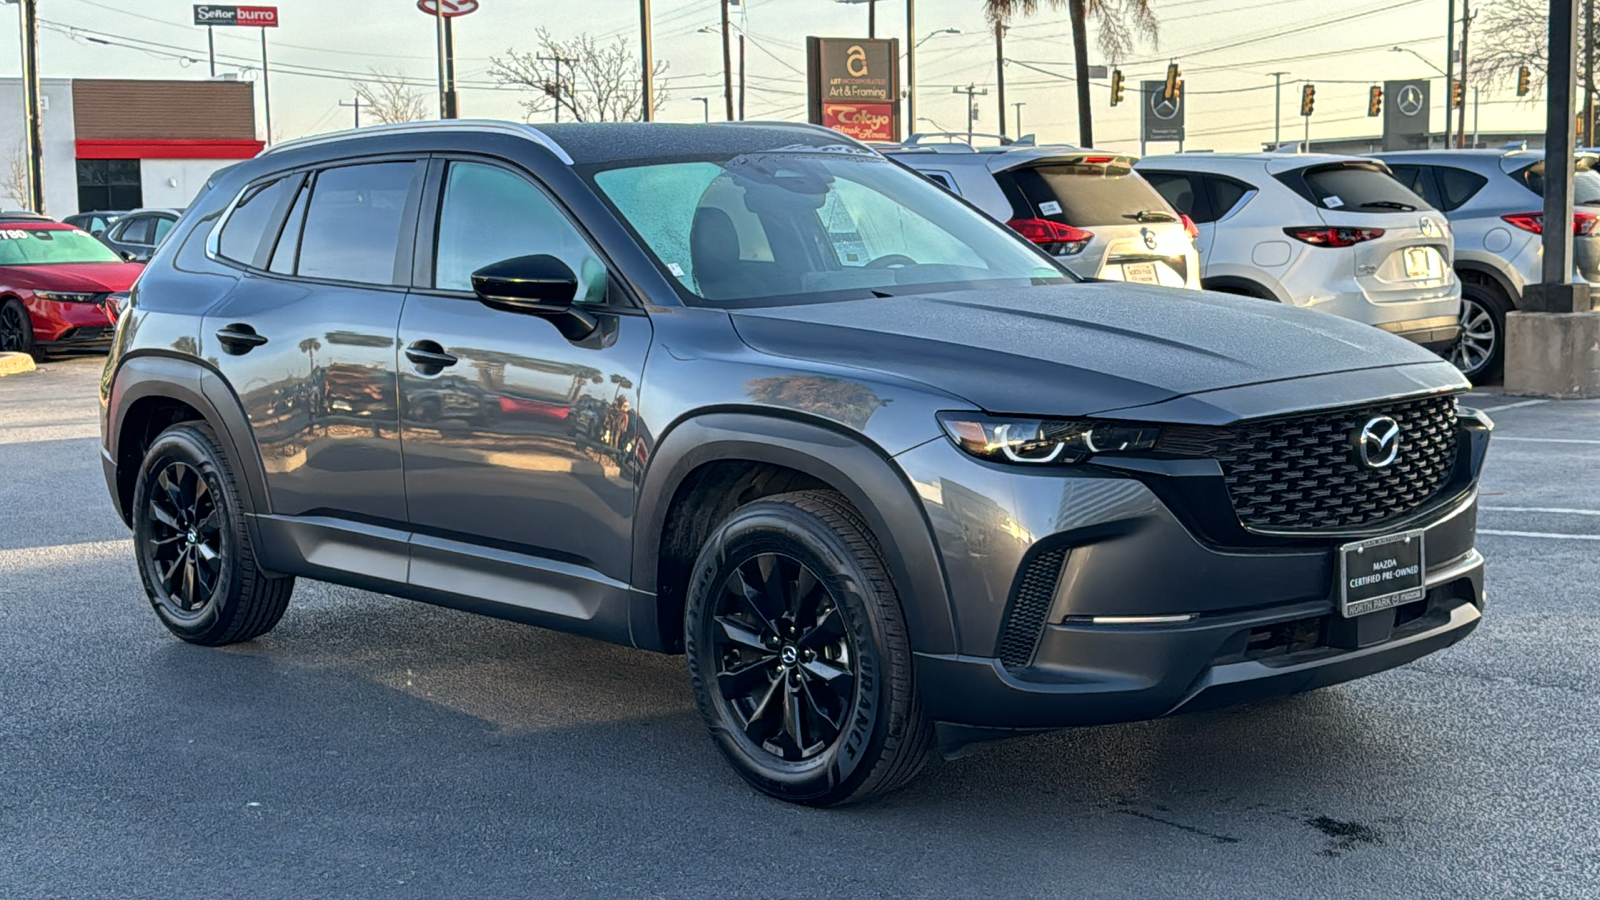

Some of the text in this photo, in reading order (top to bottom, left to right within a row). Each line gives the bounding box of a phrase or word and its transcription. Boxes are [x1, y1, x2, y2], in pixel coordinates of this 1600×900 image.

[197, 6, 274, 20] Señor burro
[829, 85, 886, 99] Art & Framing
[827, 105, 889, 130] Tokyo
[1373, 558, 1397, 571] MAZDA
[1349, 565, 1418, 588] CERTIFIED PRE-OWNED
[1349, 596, 1391, 615] NORTH PARK
[844, 604, 873, 760] URANCE
